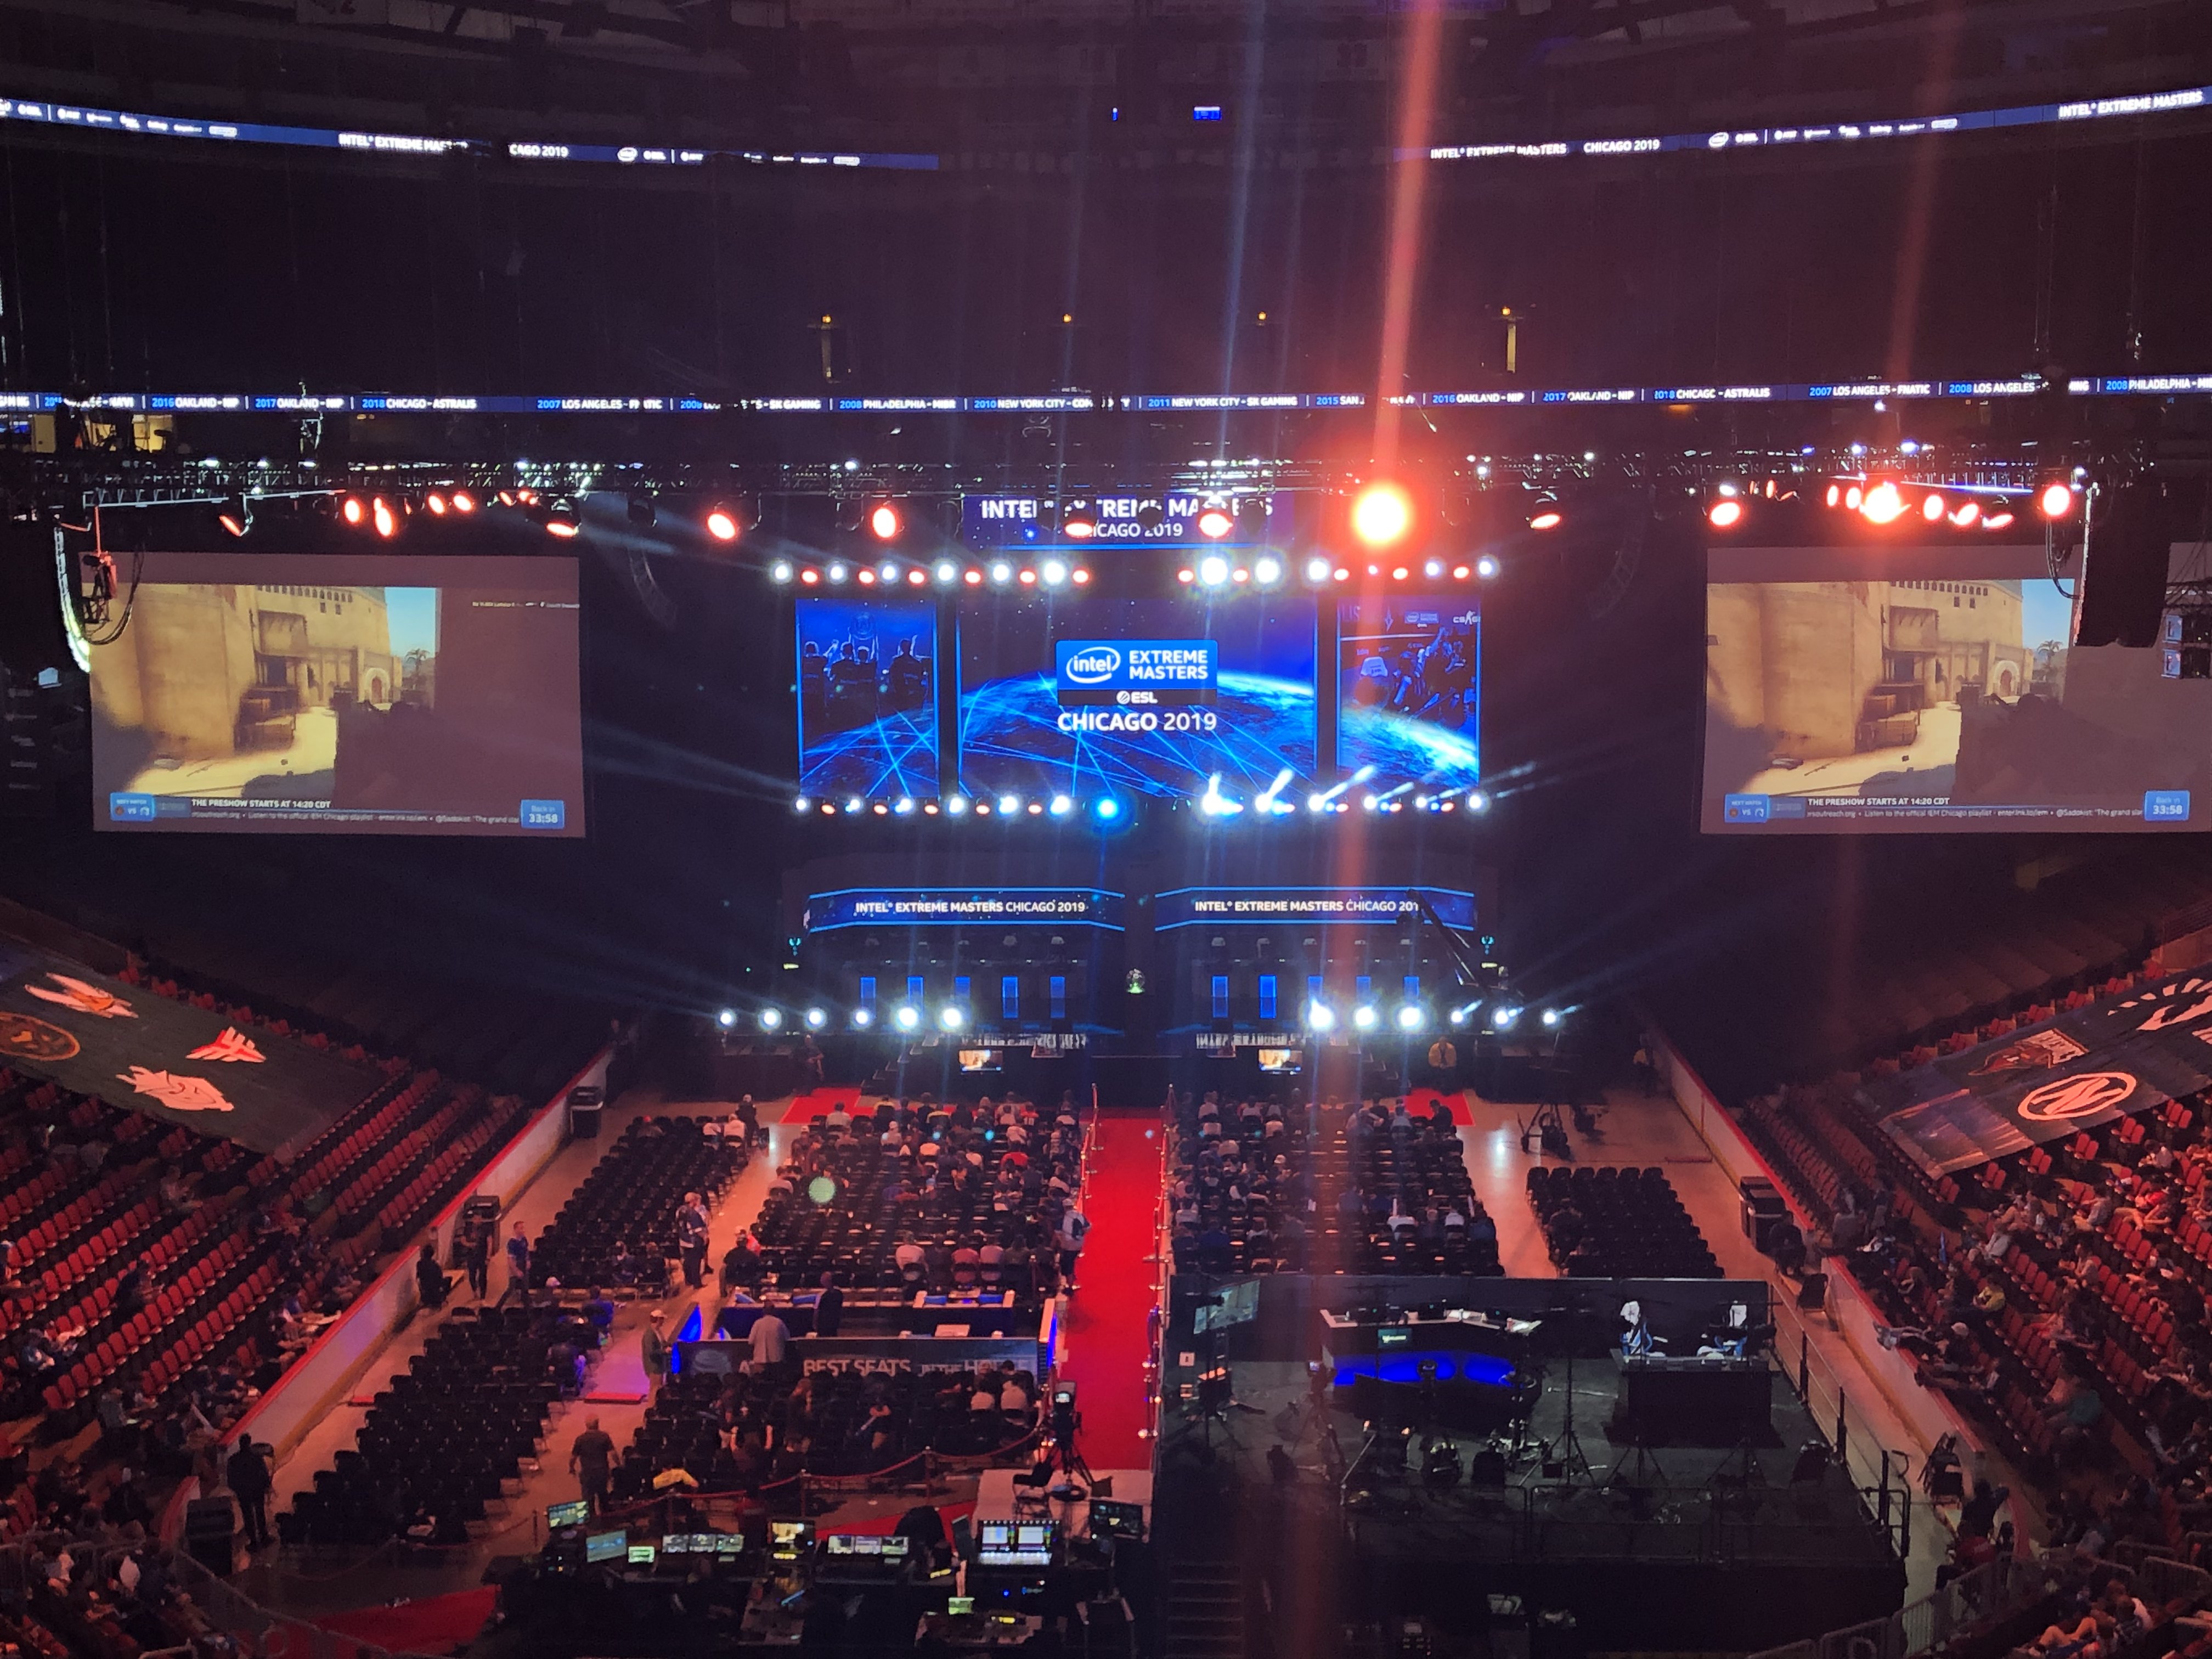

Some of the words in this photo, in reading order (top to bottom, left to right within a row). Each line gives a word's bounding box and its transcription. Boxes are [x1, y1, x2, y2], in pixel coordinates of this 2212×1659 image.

[2098, 98, 2151, 113] EXTREME
[2153, 91, 2203, 108] MASTERS
[375, 136, 422, 150] EXTREME
[1583, 140, 1632, 153] CHICAGO
[1634, 139, 1660, 150] 2019
[542, 144, 569, 157] 2019
[1517, 143, 1567, 155] MASTERS
[1949, 384, 1972, 393] 2008
[1973, 383, 1992, 393] LOS
[1994, 382, 2036, 392] ANGELES
[2106, 380, 2128, 390] 2008
[2129, 378, 2191, 389] PHILADELPHIA
[1543, 392, 1566, 401] 2017
[1618, 391, 1634, 400] NIP
[1724, 388, 1770, 398] ASTRALIS
[1810, 387, 1832, 397] 2007
[1833, 386, 1850, 396] LOS
[1851, 386, 1891, 395] ANGELES
[1897, 385, 1930, 394] FNATIC
[153, 397, 174, 407] 2016
[176, 397, 217, 408] OAKLAND
[255, 398, 276, 407] 2017
[277, 398, 319, 408] OAKLAND
[1148, 398, 1170, 407] 2011
[1172, 398, 1194, 407] NEW
[1194, 398, 1218, 407] YORK
[1219, 398, 1240, 407] CITY
[1247, 397, 1259, 407] SK
[1261, 397, 1297, 407] GAMING
[1317, 397, 1338, 405] 2015
[1340, 396, 1359, 405] SAN
[1433, 395, 1455, 403] 2016
[1457, 393, 1499, 403] OAKLAND
[1507, 392, 1524, 402] NIP
[363, 399, 385, 408] 2018
[386, 398, 426, 408] CHICAGO
[433, 398, 477, 409] ASTRALIS
[538, 400, 561, 409] 2007
[562, 399, 581, 409] LOS
[582, 399, 623, 409] ANGELES
[769, 399, 782, 409] SK
[783, 399, 821, 410] GAMING
[839, 400, 862, 409] 2008
[863, 399, 927, 409] PHILADELPHIA
[974, 399, 997, 408] 2010
[998, 399, 1020, 408] NEW
[1020, 399, 1044, 408] YORK
[1045, 399, 1065, 408] CITY
[1074, 655, 1112, 672] intel
[1129, 650, 1208, 664] EXTREME
[1129, 665, 1209, 680] MASTERS
[1131, 692, 1158, 704] ESL
[1057, 713, 1158, 731] CHICAGO
[1164, 713, 1217, 731] 2019
[2153, 805, 2182, 815] 33:58
[529, 813, 558, 823] 33:58
[895, 902, 949, 913] EXTREME
[951, 901, 1003, 913] MASTERS
[1006, 901, 1056, 913] CHICAGO
[1057, 901, 1086, 912] 2019
[1234, 901, 1288, 912] EXTREME
[1290, 901, 1344, 912] MASTERS
[1346, 900, 1396, 912] CHICAGO
[1399, 901, 1419, 912] 201
[803, 1359, 850, 1376] BEST
[854, 1359, 911, 1376] SEATS
